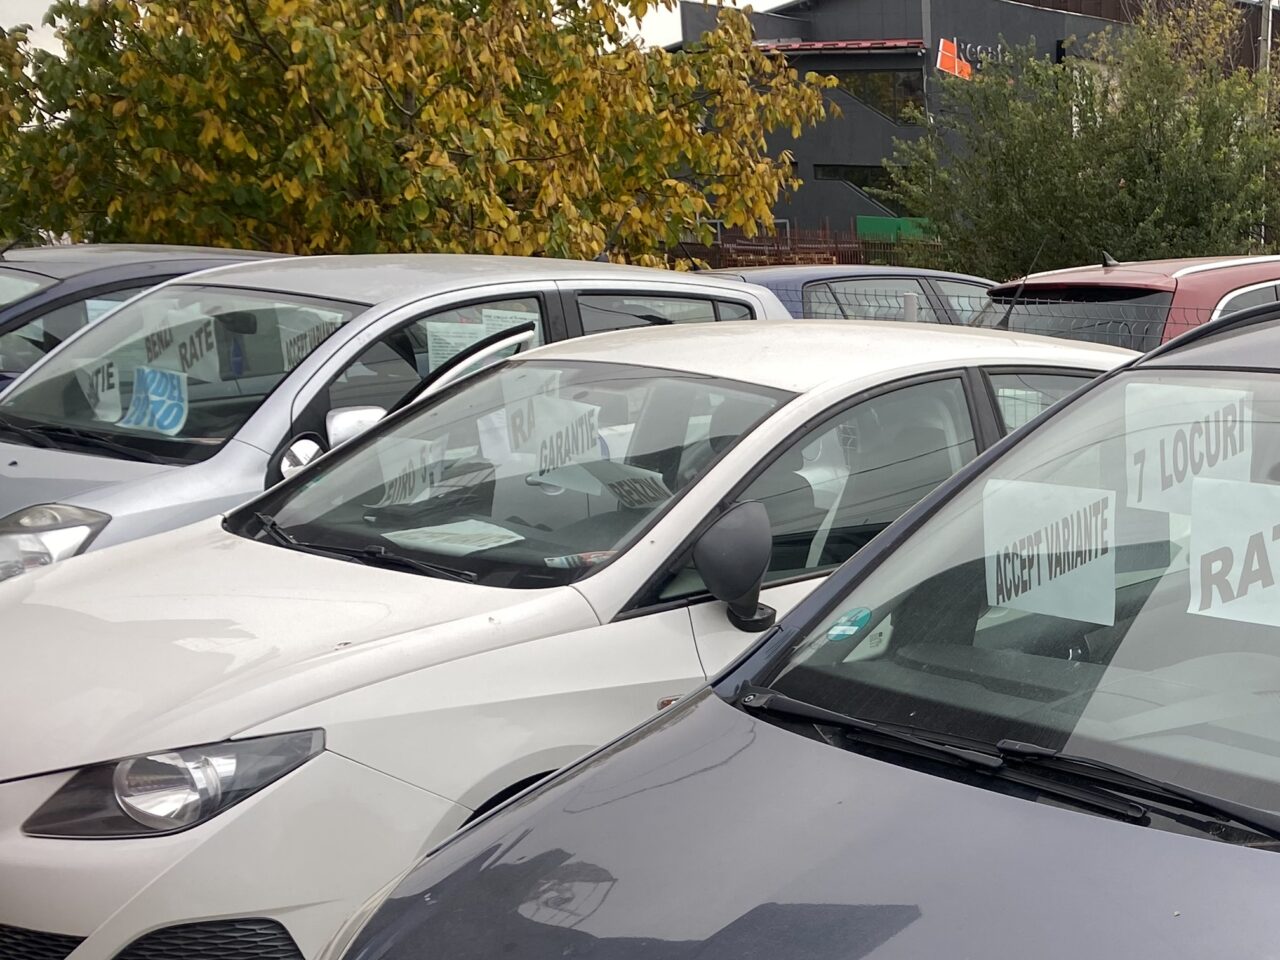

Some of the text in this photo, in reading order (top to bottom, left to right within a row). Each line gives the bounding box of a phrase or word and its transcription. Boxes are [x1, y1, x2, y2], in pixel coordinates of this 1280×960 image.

[178, 319, 214, 373] RATE
[539, 407, 597, 477] GARANTIE
[1133, 396, 1245, 503] 7 LOCURI
[996, 496, 1108, 606] ACCEPT VARIANTE
